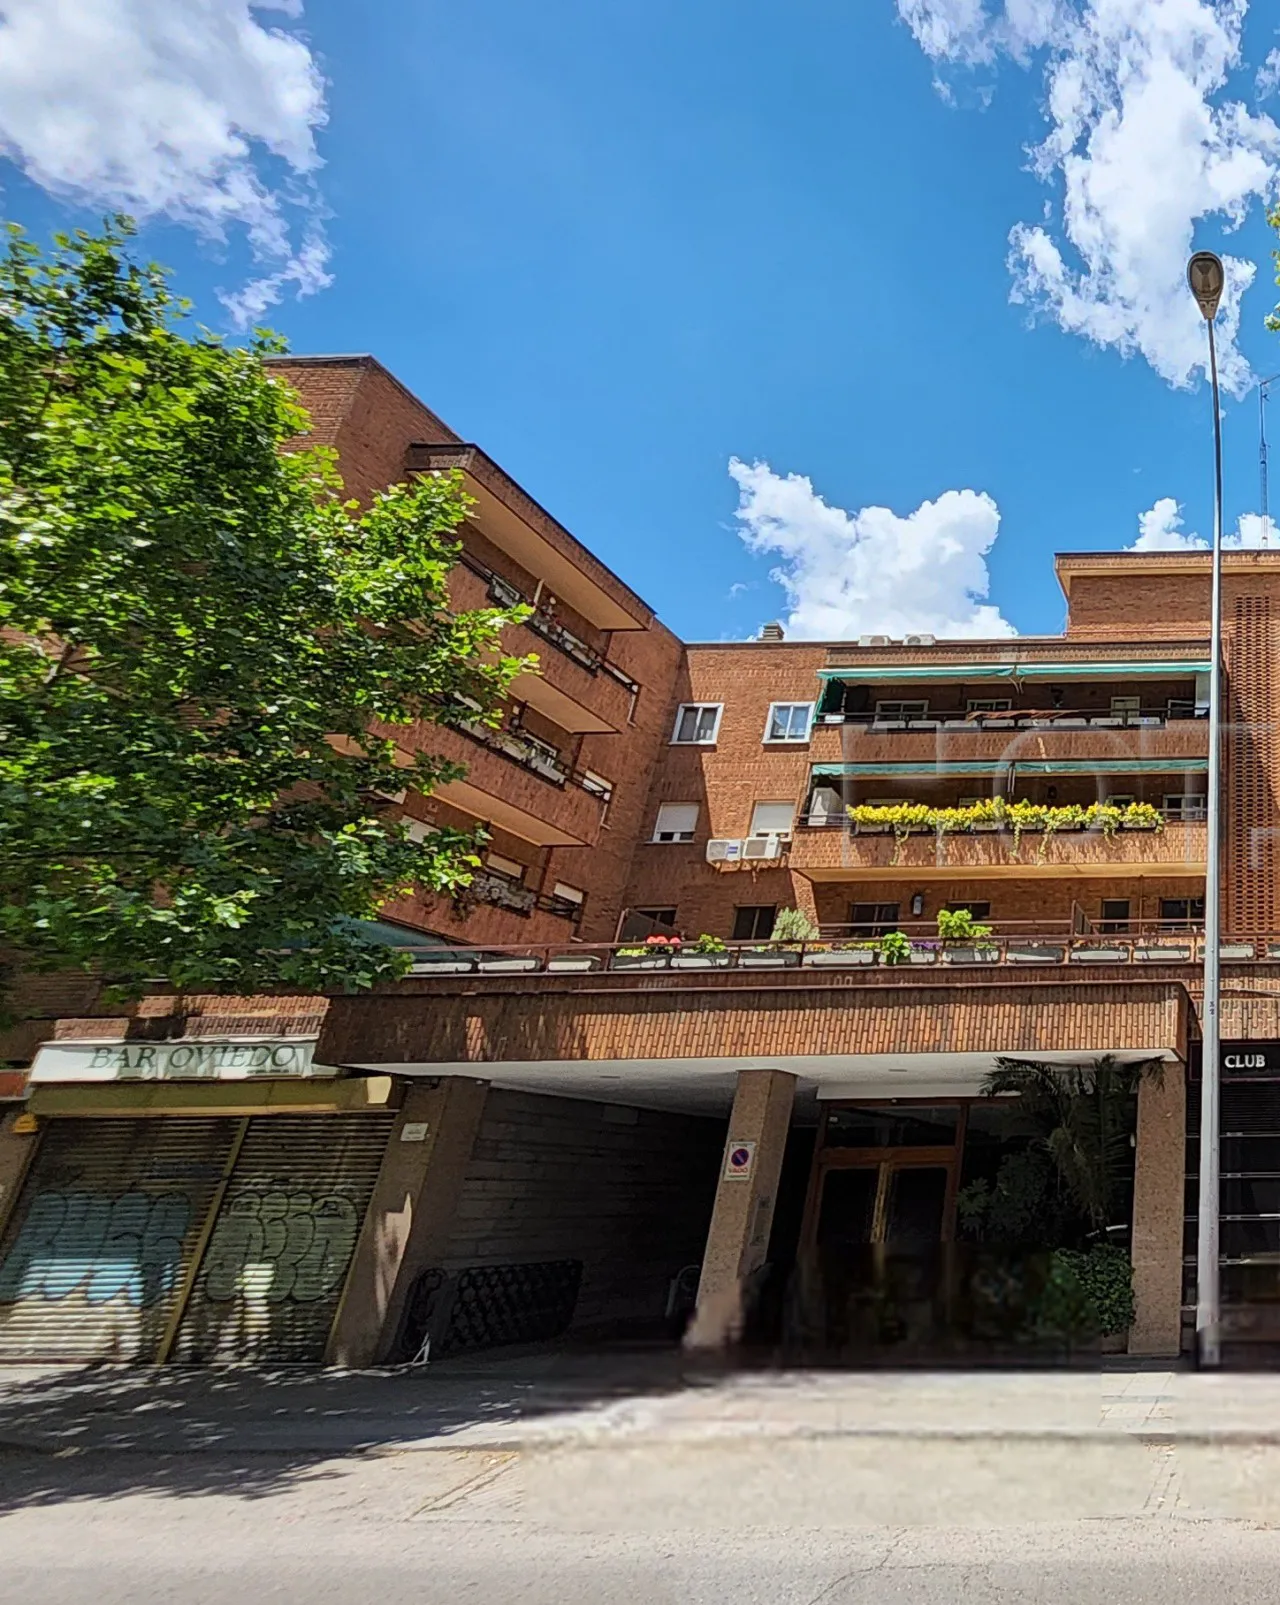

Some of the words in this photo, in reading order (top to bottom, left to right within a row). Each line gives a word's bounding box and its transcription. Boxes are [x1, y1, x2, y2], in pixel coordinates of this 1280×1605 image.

[84, 1046, 157, 1069] BAR
[168, 1045, 297, 1069] OVIEDO
[1224, 1054, 1266, 1069] CLUB
